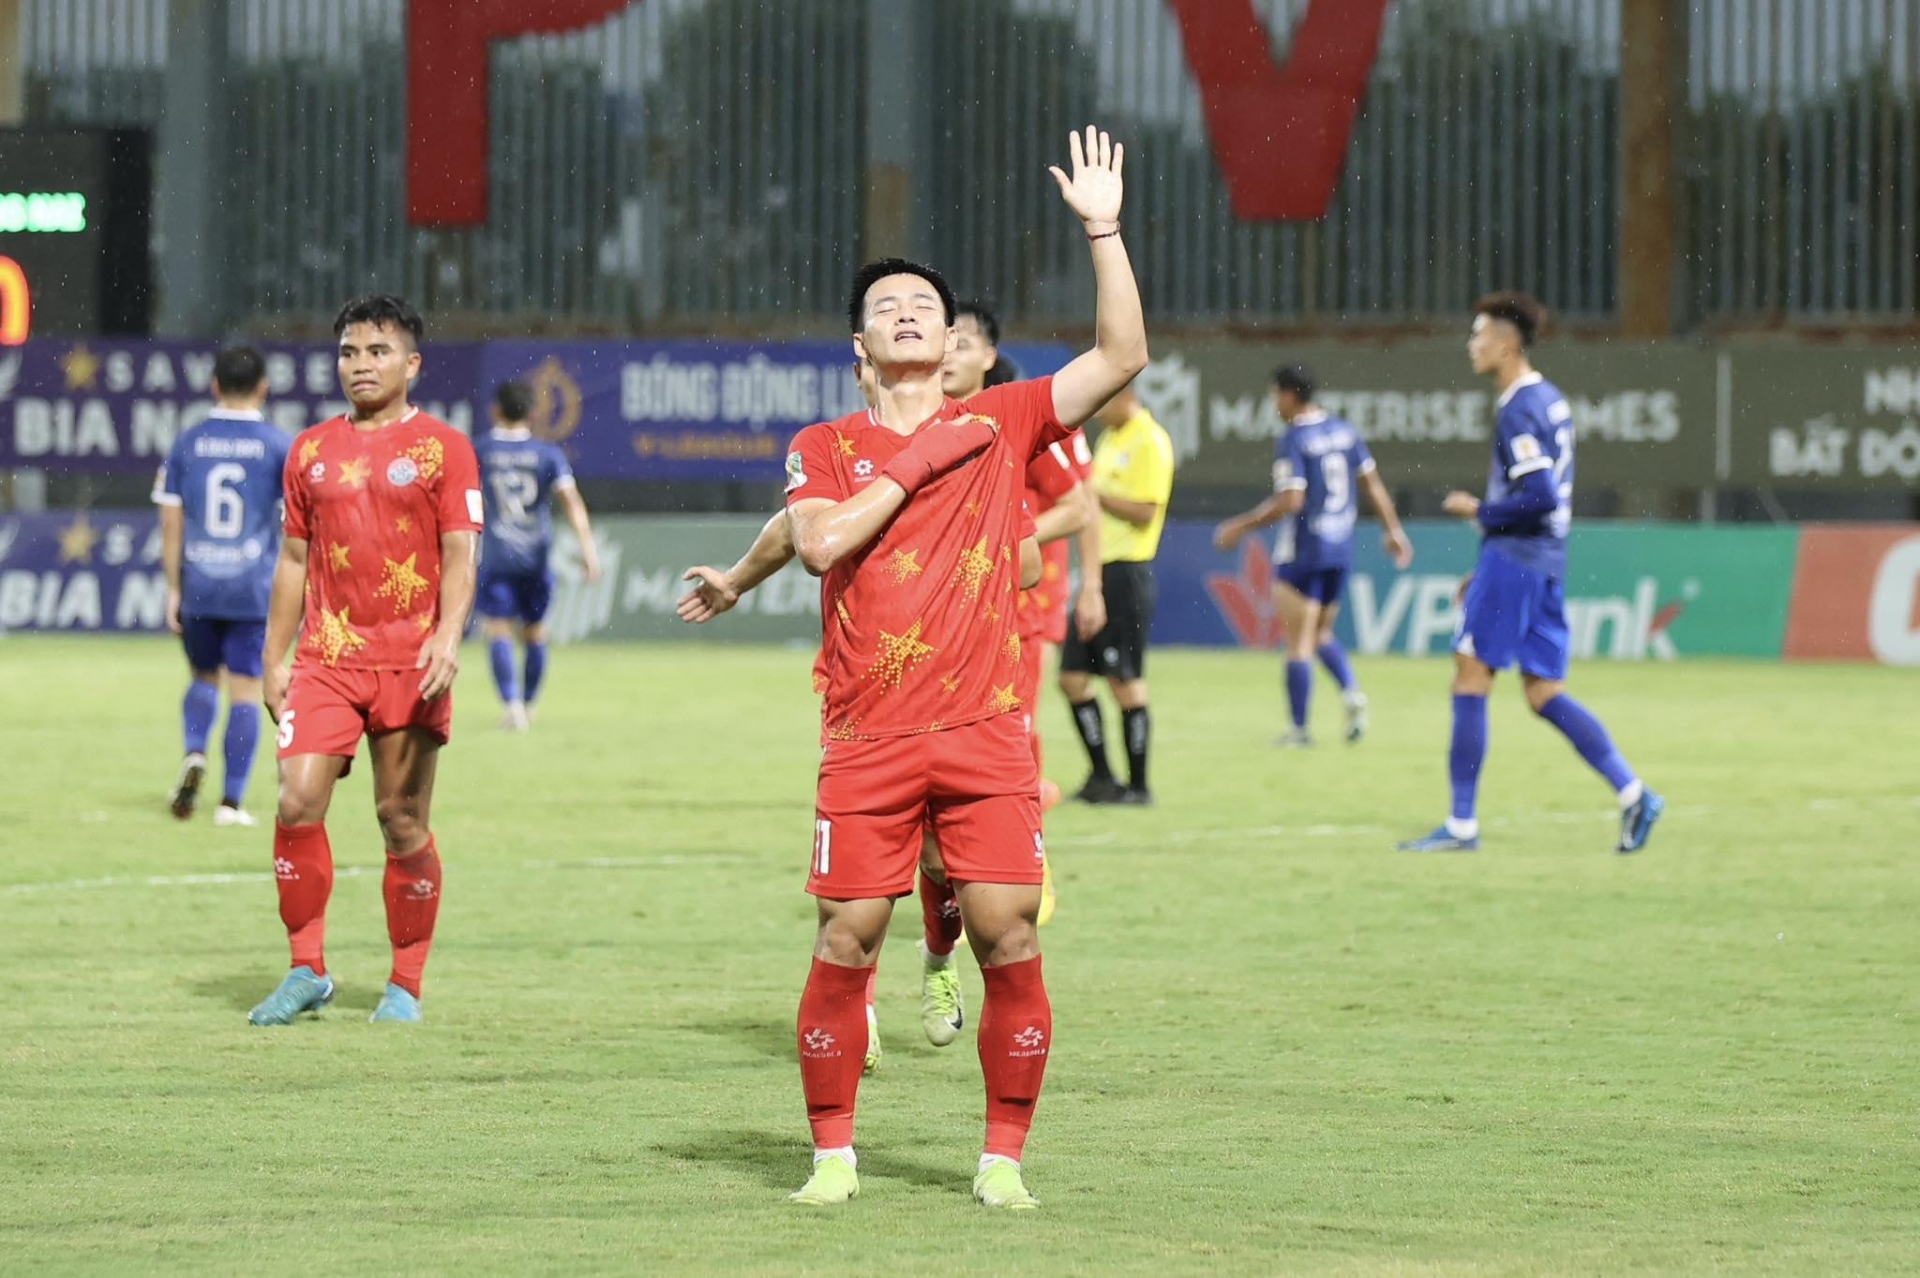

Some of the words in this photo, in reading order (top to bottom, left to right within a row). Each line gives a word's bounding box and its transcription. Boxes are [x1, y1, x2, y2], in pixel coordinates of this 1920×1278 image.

[14, 397, 121, 458] BIA
[204, 460, 247, 540] 6
[0, 569, 102, 630] BIA
